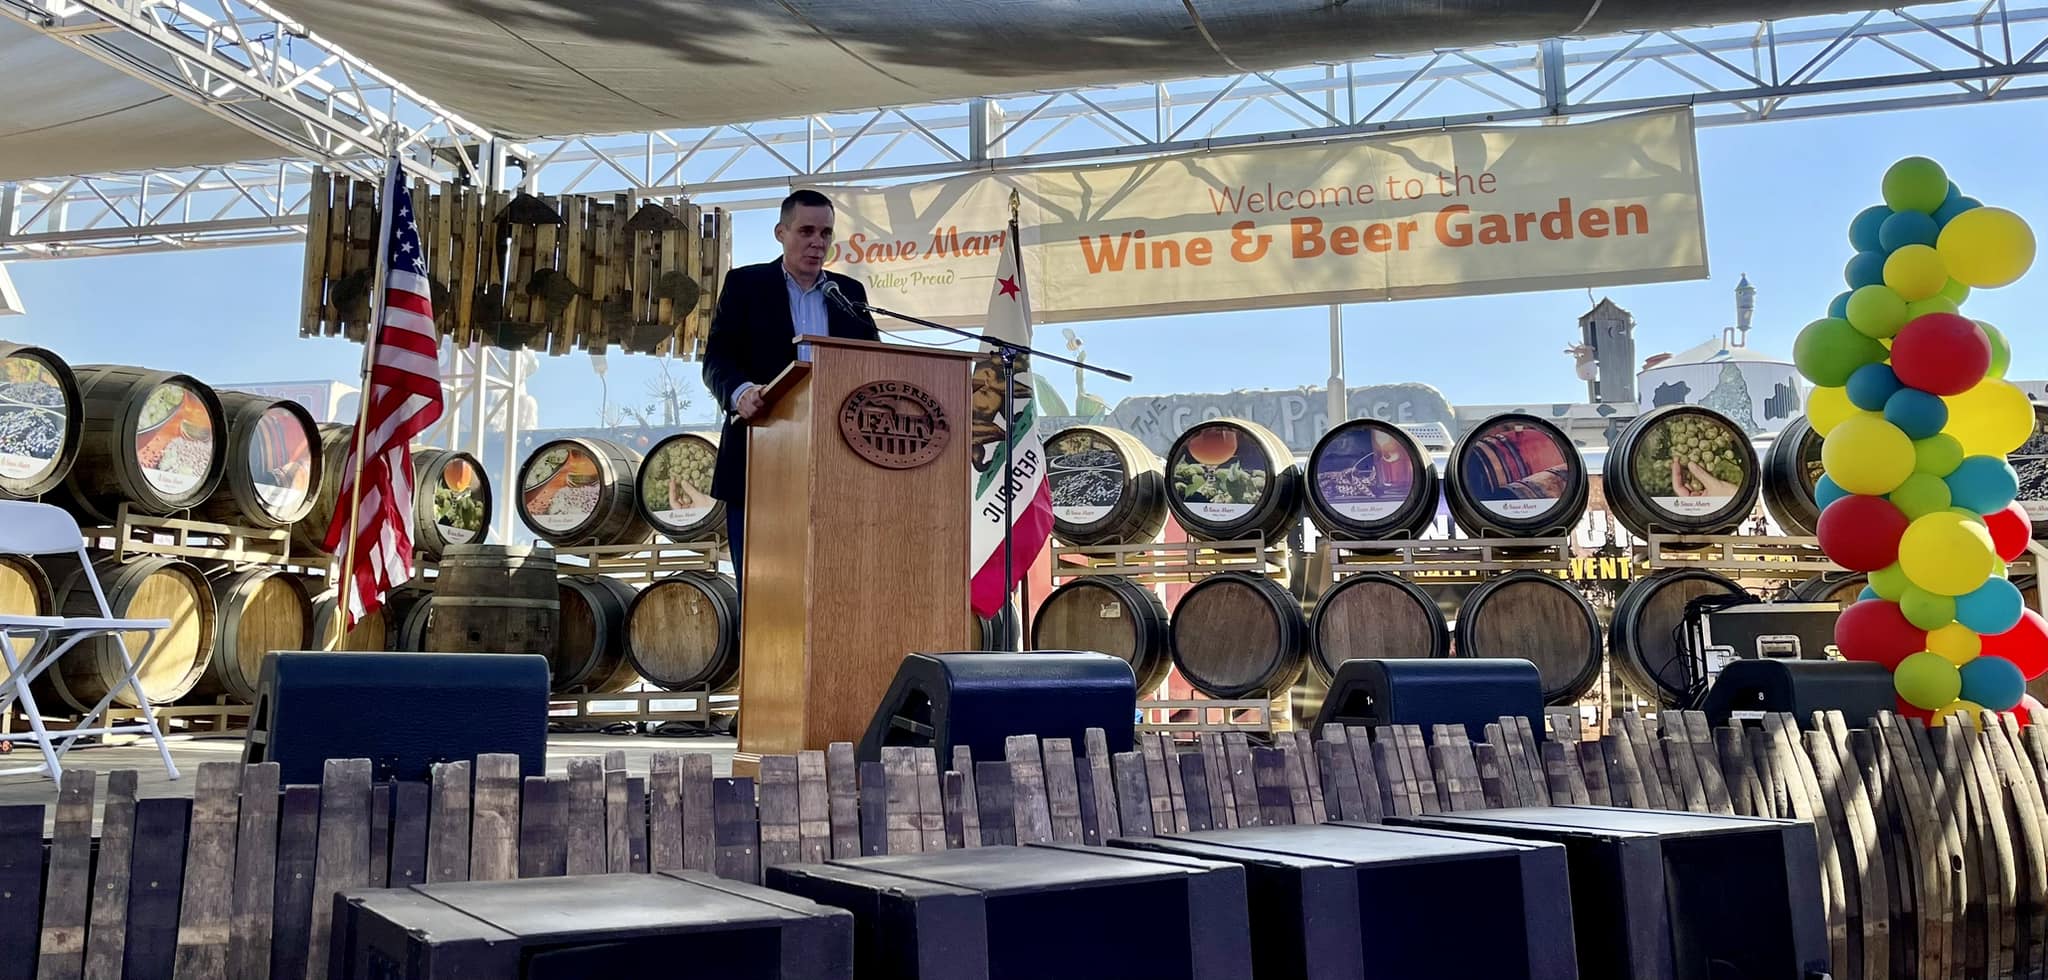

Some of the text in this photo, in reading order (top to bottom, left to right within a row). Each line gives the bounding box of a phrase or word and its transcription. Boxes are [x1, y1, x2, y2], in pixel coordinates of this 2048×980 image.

[1208, 166, 1497, 216] Welcome to the
[845, 232, 919, 264] Save
[1079, 197, 1649, 274] Wine & Beer Garden
[868, 270, 955, 294] Valley Proud
[845, 391, 867, 423] THE
[869, 382, 897, 396] BIG
[1131, 397, 1168, 434] THE
[861, 410, 931, 440] FAIR
[1558, 556, 1632, 580] VENT
